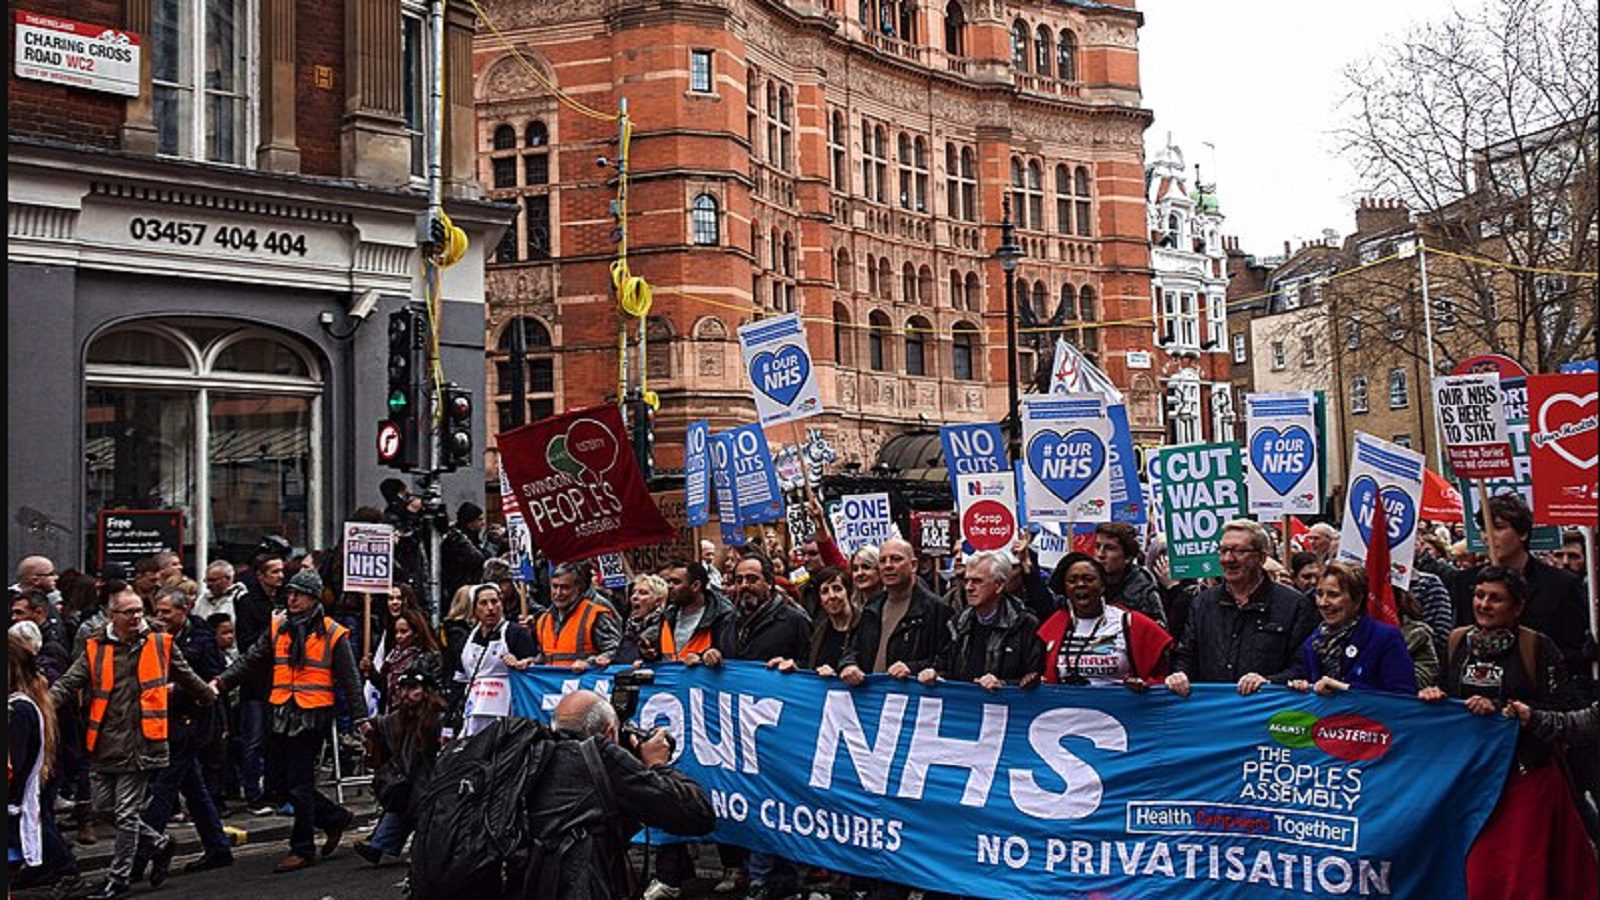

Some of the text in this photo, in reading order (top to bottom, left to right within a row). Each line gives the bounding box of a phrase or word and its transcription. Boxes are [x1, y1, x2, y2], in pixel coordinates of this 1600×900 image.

[24, 32, 132, 63] CHARING CROSS
[24, 46, 94, 71] ROAD WC2
[130, 217, 307, 257] 03457 404 404
[771, 355, 798, 371] OUR
[764, 366, 802, 392] NHS
[1438, 387, 1464, 406] OUR
[1467, 385, 1498, 404] NHS
[1441, 404, 1493, 424] IS HERE
[1445, 422, 1496, 443] TO STAY
[949, 429, 994, 458] NO
[1056, 443, 1093, 457] OUR
[1275, 439, 1305, 452] OUR
[734, 455, 764, 474] UTS
[955, 457, 999, 474] CUTS
[1042, 459, 1093, 480] NHS
[1166, 448, 1233, 482] CUT
[1262, 453, 1305, 474] NHS
[522, 472, 573, 497] SWINDON
[1166, 478, 1239, 509] WAR
[844, 499, 889, 520] ONE
[973, 513, 1003, 526] Scrap
[107, 517, 132, 528] Free
[847, 521, 889, 537] FIGHT
[969, 525, 987, 536] the
[1171, 507, 1240, 541] NOT
[1358, 503, 1402, 540] NS
[921, 528, 951, 548] A&E
[1173, 541, 1220, 556] WELFA
[349, 553, 388, 577] NHS
[1268, 723, 1391, 745] AGAINST AUSTERITY
[808, 689, 1128, 820] NHS
[1257, 746, 1291, 763] THE
[1242, 761, 1362, 793] PEOPLES
[1239, 783, 1361, 811] ASSEMBLY
[711, 789, 903, 851] NO CLOSURES
[1136, 807, 1192, 826] Health
[1273, 814, 1350, 842] Together
[977, 834, 1391, 895] NO PRIVATISATION
